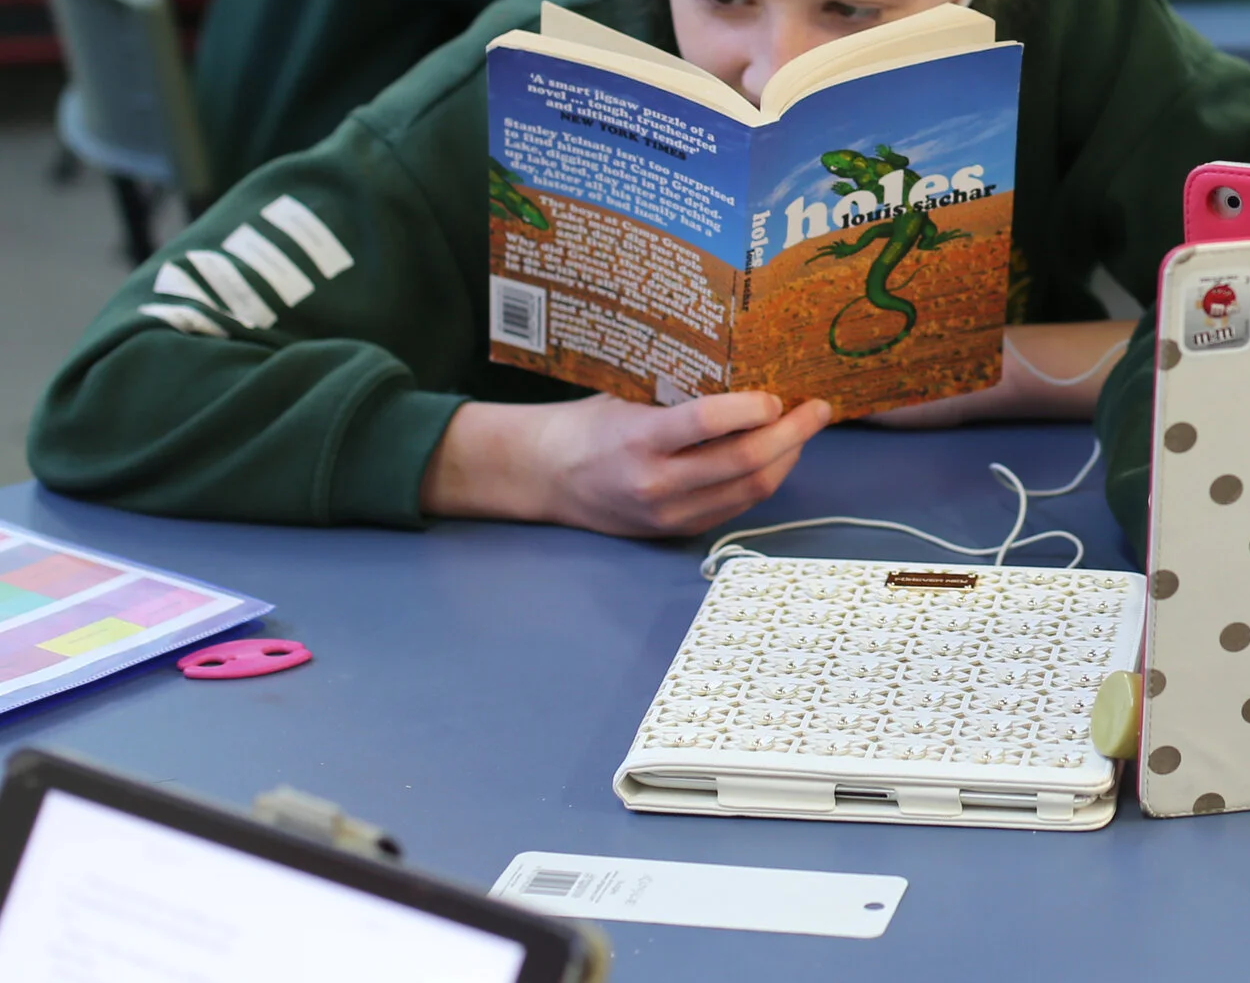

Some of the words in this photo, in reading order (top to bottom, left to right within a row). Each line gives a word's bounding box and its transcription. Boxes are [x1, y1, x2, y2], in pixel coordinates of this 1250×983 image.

[528, 84, 565, 100] novel
[588, 97, 632, 122] tough,
[637, 113, 716, 153] truehearted
[546, 99, 572, 111] and
[577, 106, 647, 137] ultimately
[548, 79, 589, 96] smart
[594, 89, 638, 111] jigsaw
[643, 107, 688, 130] puzzle
[504, 116, 557, 140] Stanley
[562, 131, 612, 155] Yelnats
[616, 147, 644, 165] isn't
[648, 157, 669, 175] too
[673, 171, 735, 206] surprised
[560, 110, 593, 127] NEW
[599, 121, 639, 142] YORK
[643, 135, 686, 160] TIMES
[505, 137, 542, 157] Lake,
[546, 147, 598, 173] digging
[603, 163, 637, 183] holes
[659, 184, 680, 201] the
[510, 158, 538, 174] day.
[543, 166, 581, 185] After
[585, 179, 606, 195] all,
[610, 186, 630, 202] his
[635, 195, 676, 222] family
[680, 214, 701, 232] has
[522, 130, 552, 147] find
[557, 140, 609, 163] himself
[630, 162, 667, 187] Camp
[672, 178, 710, 204] Green
[527, 152, 556, 169] lake
[561, 161, 591, 180] bed,
[594, 170, 618, 189] day
[623, 183, 655, 201] after
[659, 198, 720, 234] scorching
[533, 173, 582, 198] history
[606, 194, 629, 211] bad
[783, 164, 984, 249] holes
[842, 202, 904, 228] louis
[912, 184, 996, 213] sachar
[745, 249, 755, 275] louis
[751, 210, 770, 268] holes
[742, 277, 752, 312] sachar
